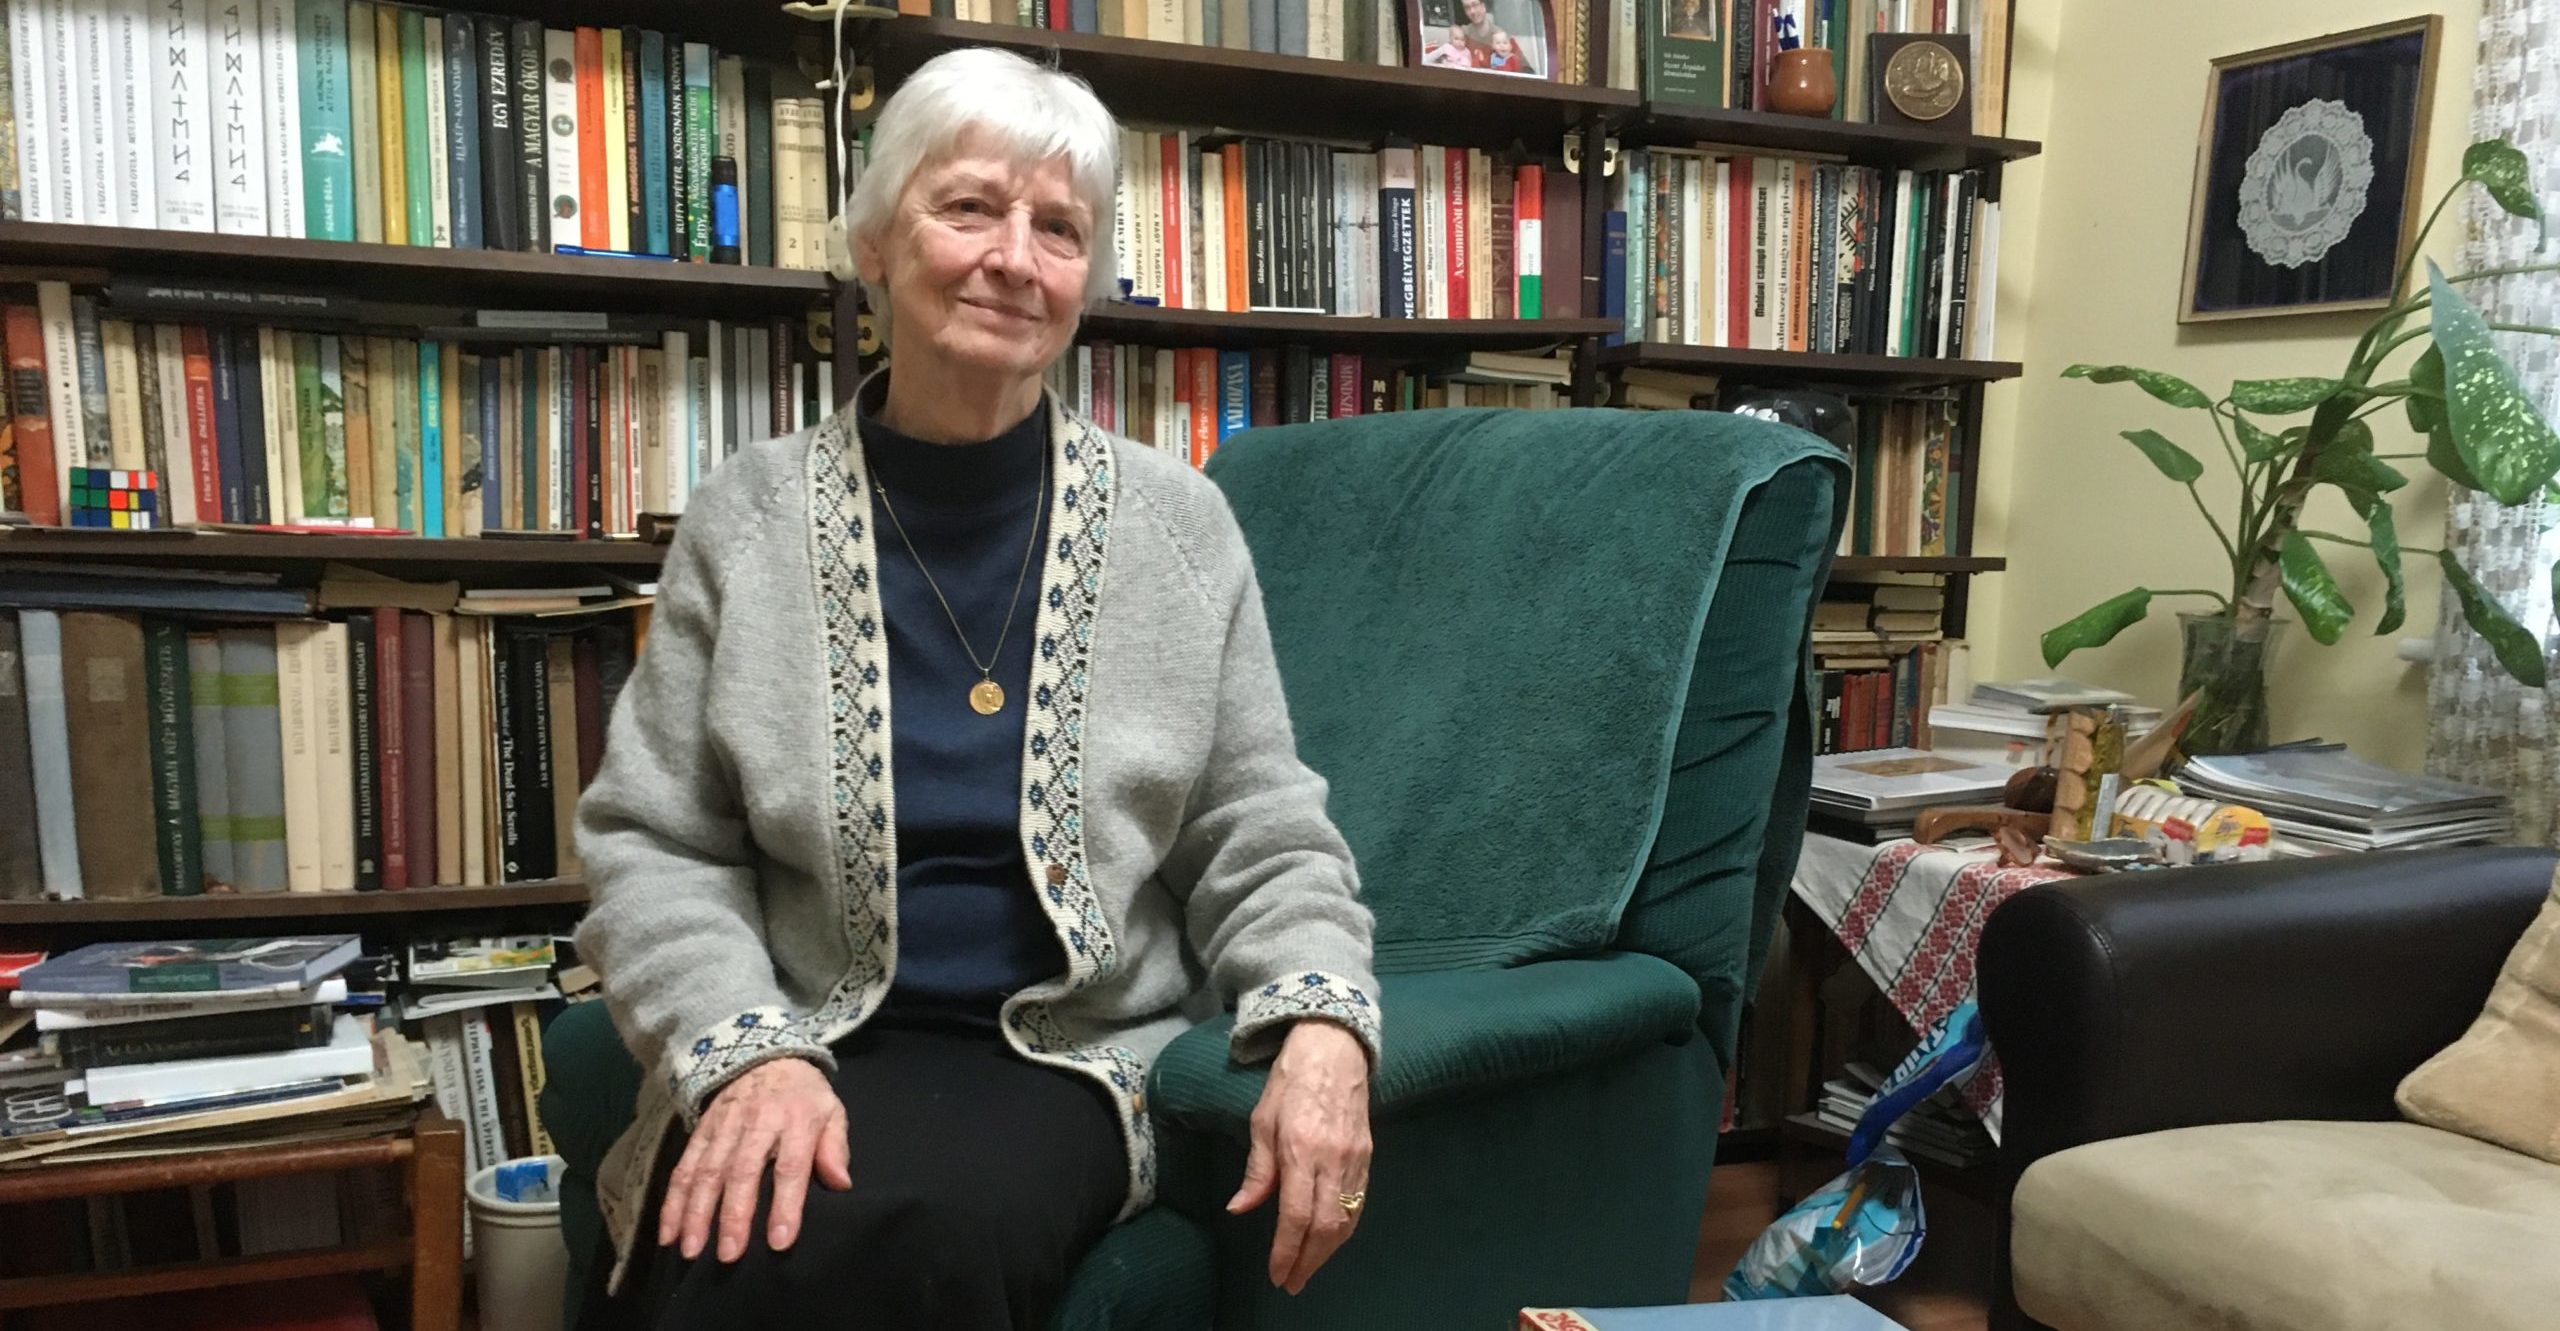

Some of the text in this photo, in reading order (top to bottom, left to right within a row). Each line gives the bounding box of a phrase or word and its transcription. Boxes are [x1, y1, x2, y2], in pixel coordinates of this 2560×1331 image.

[486, 27, 508, 128] EGY EZREDÉV
[517, 49, 540, 90] ÓKOR
[523, 92, 541, 155] MAGYAR
[670, 94, 683, 160] KORONÁNK
[525, 157, 542, 168] A
[670, 165, 684, 198] PÉTER
[674, 200, 685, 234] RUFFY
[1812, 171, 1822, 249] NÉPHAGYOMÁNY
[788, 238, 798, 249] 2
[1256, 240, 1264, 259] Áron
[1401, 197, 1415, 319] MEGBÉLYEGZETTEK
[1669, 229, 1678, 272] NÉPRAJZ
[1812, 250, 1819, 262] ÉS
[1135, 249, 1143, 290] TRAGÉDIA
[1154, 248, 1162, 289] TRAGÉDIA
[1257, 259, 1265, 283] Gábor
[1670, 274, 1678, 316] MAGYAR
[1754, 282, 1765, 317] Moldvai
[1314, 369, 1329, 420] HORTH
[1340, 365, 1354, 418] MINDSZE
[356, 640, 372, 837] THE ILLUSTRATED HISTORY OF HUNGARY
[503, 738, 514, 759] The
[504, 761, 515, 789] Dead
[505, 791, 516, 808] Sea
[506, 811, 518, 846] Scrolls
